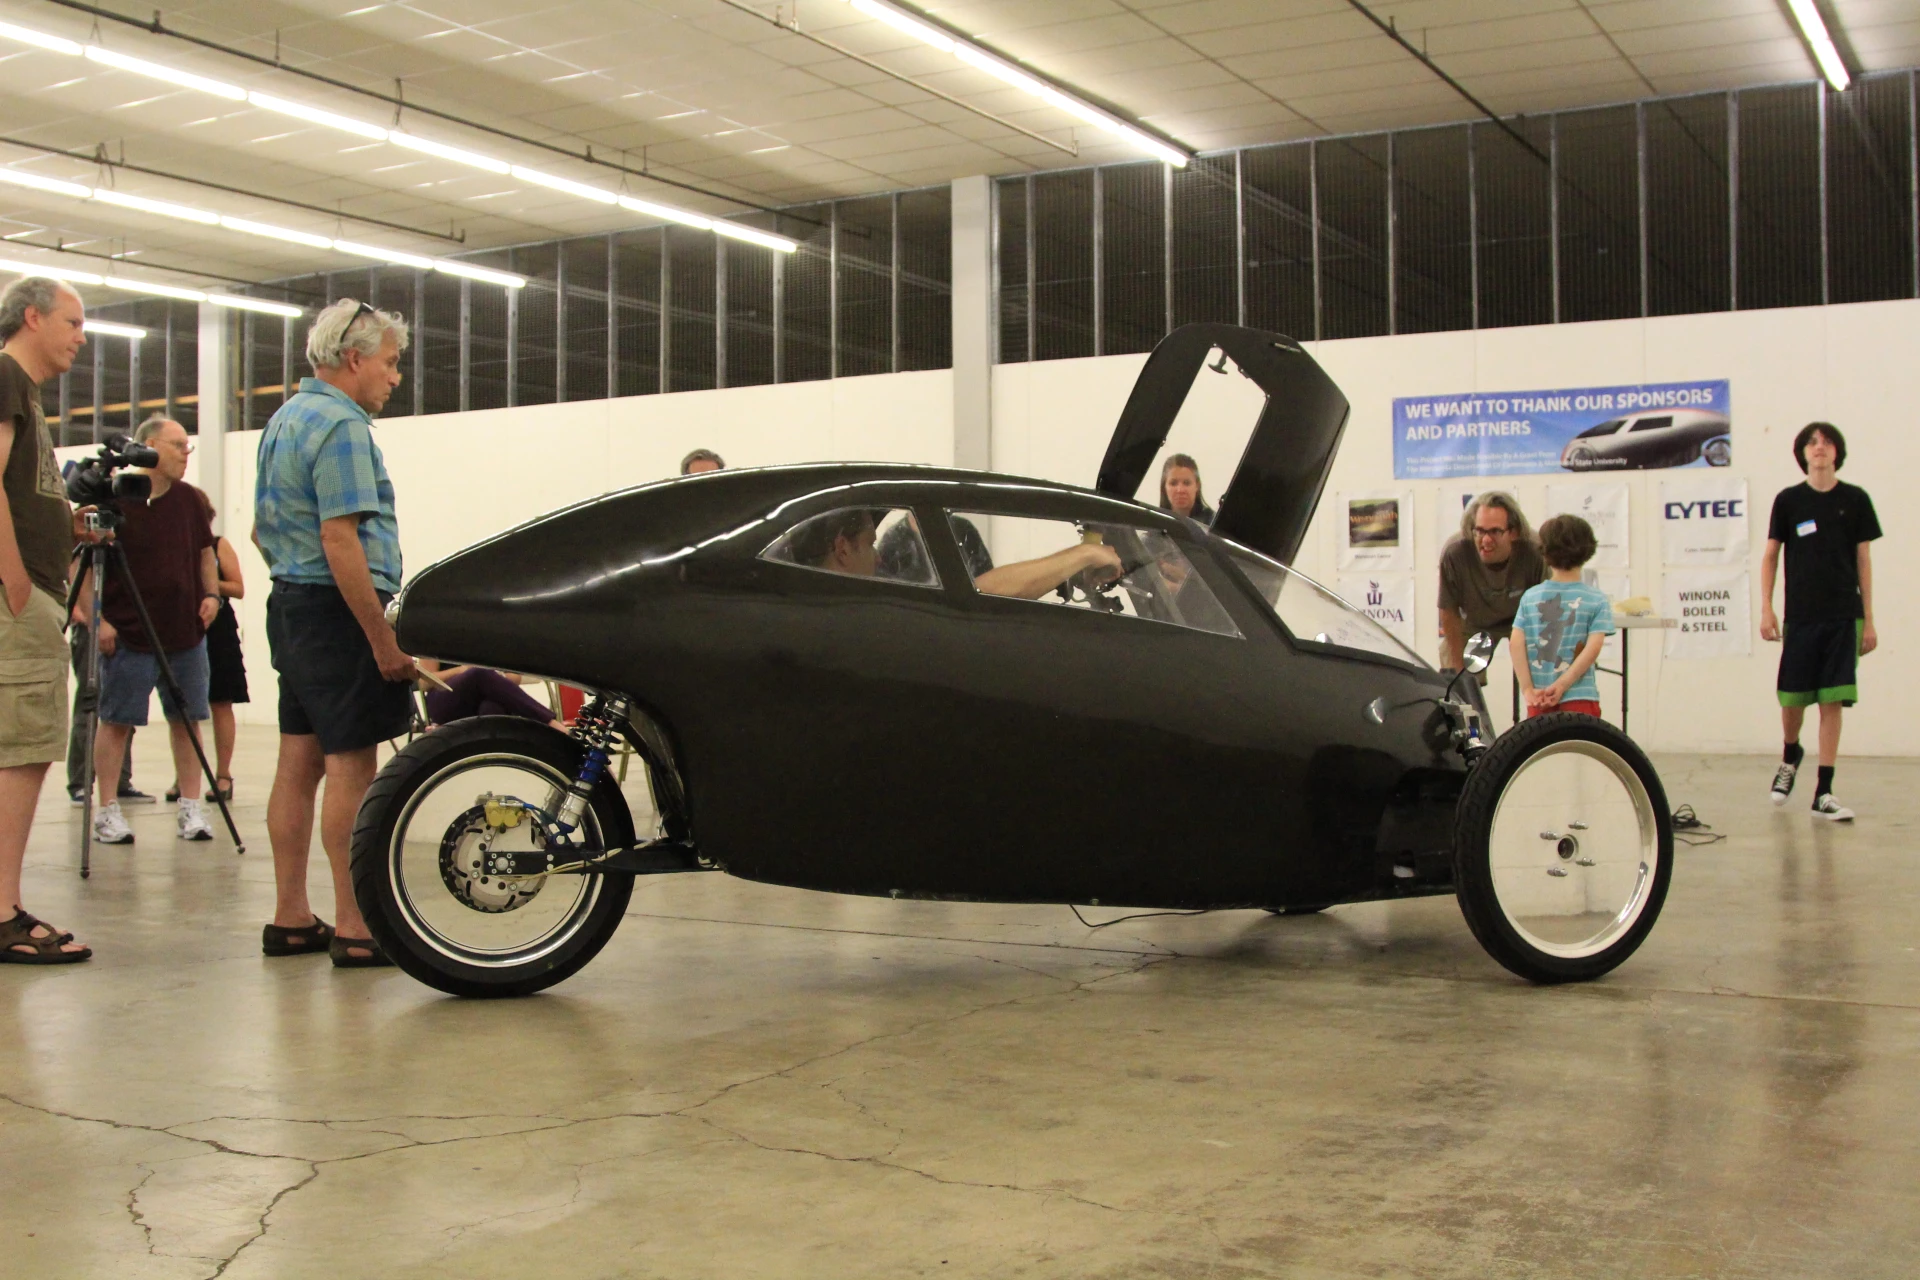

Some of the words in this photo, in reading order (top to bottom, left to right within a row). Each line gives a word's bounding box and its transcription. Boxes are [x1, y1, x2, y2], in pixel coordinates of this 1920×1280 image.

[1405, 403, 1431, 419] WE
[1434, 400, 1483, 417] WANT
[1486, 399, 1508, 415] TO
[1511, 396, 1571, 413] THANK
[1574, 394, 1613, 411] OUR
[1616, 388, 1713, 409] SPONSORS
[1405, 425, 1443, 441] AND
[1446, 419, 1531, 438] PARTNERS
[1593, 457, 1628, 466] University
[1664, 499, 1743, 519] CYTEC
[1679, 590, 1730, 601] WINONA
[1682, 606, 1725, 617] BOILER
[1681, 622, 1689, 632] &
[1692, 621, 1728, 632] STEEL
